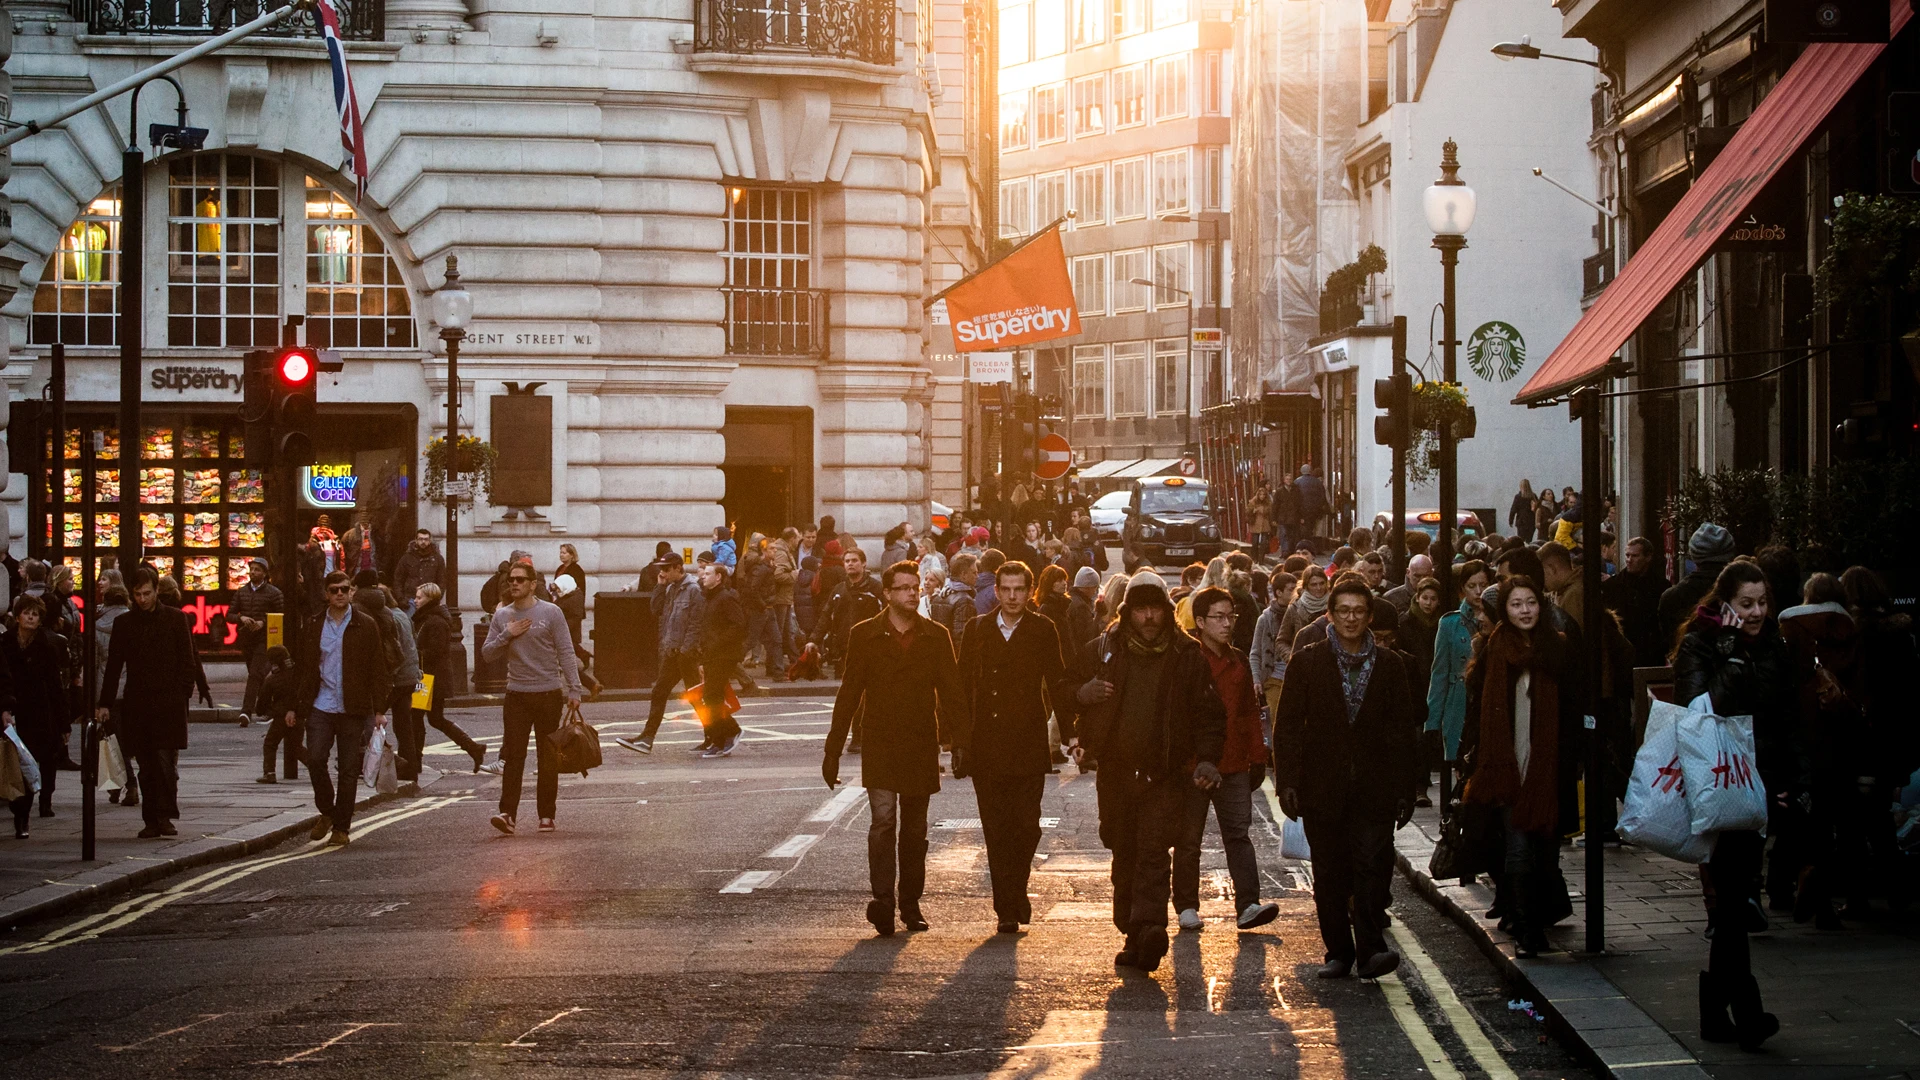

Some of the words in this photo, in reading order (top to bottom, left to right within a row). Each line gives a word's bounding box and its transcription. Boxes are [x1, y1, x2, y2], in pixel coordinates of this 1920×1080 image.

[956, 306, 1071, 343] Superdry
[460, 333, 505, 344] GENT
[516, 334, 565, 344] STREET
[151, 368, 245, 394] Superdry
[311, 464, 353, 477] T-SHIRT
[313, 476, 358, 488] GALLERY
[1893, 597, 1916, 605] AWAY
[1711, 750, 1755, 792] H&M
